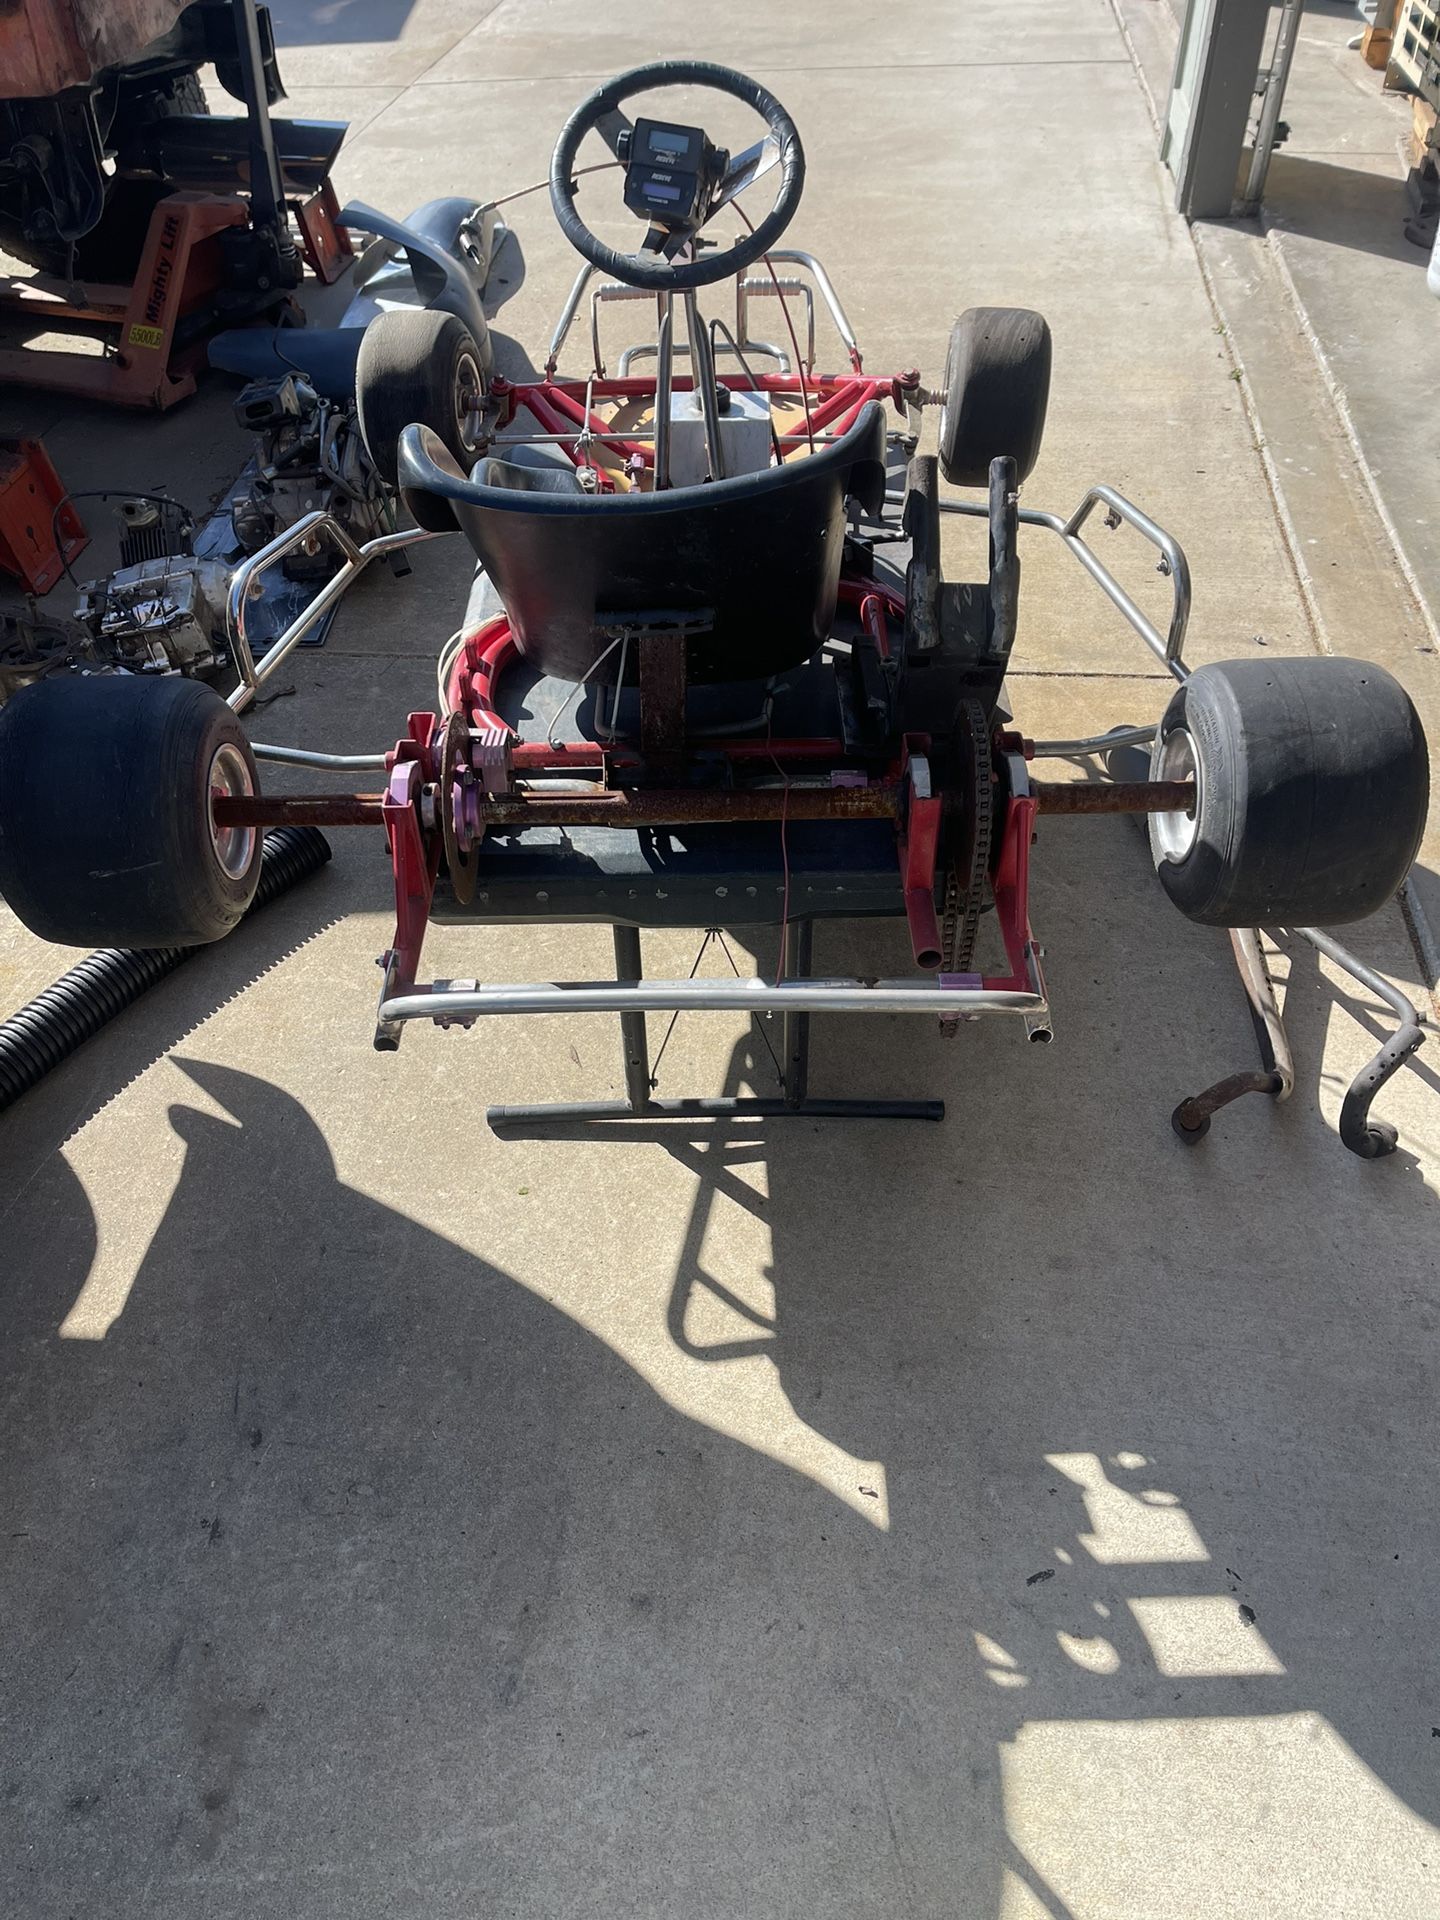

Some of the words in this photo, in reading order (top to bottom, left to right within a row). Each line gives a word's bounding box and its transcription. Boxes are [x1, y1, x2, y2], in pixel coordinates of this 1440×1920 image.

[145, 256, 172, 323] Mighty
[160, 216, 179, 250] Lift
[129, 327, 161, 345] 5500LB
